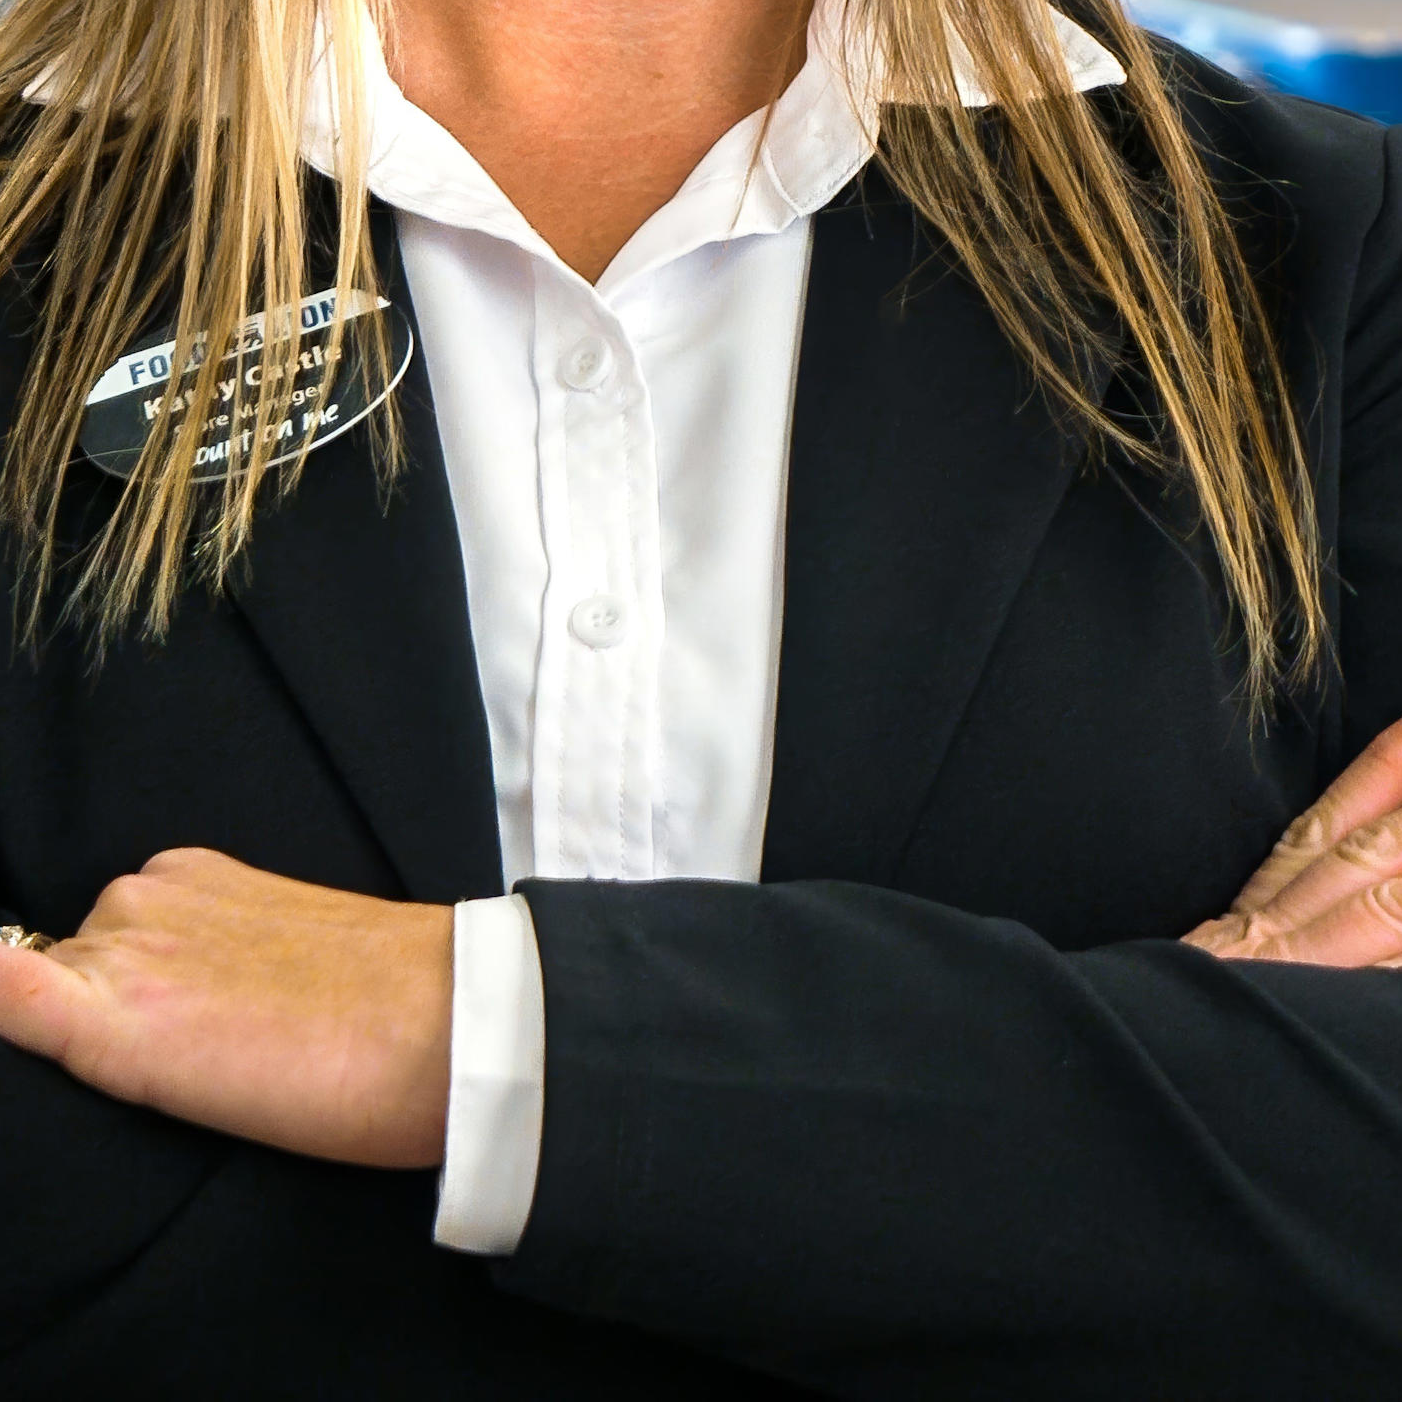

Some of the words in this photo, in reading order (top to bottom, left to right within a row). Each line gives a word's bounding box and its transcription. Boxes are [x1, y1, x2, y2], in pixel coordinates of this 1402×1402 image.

[128, 340, 210, 386] FOD
[144, 376, 237, 421] Katy
[184, 427, 254, 469] ount
